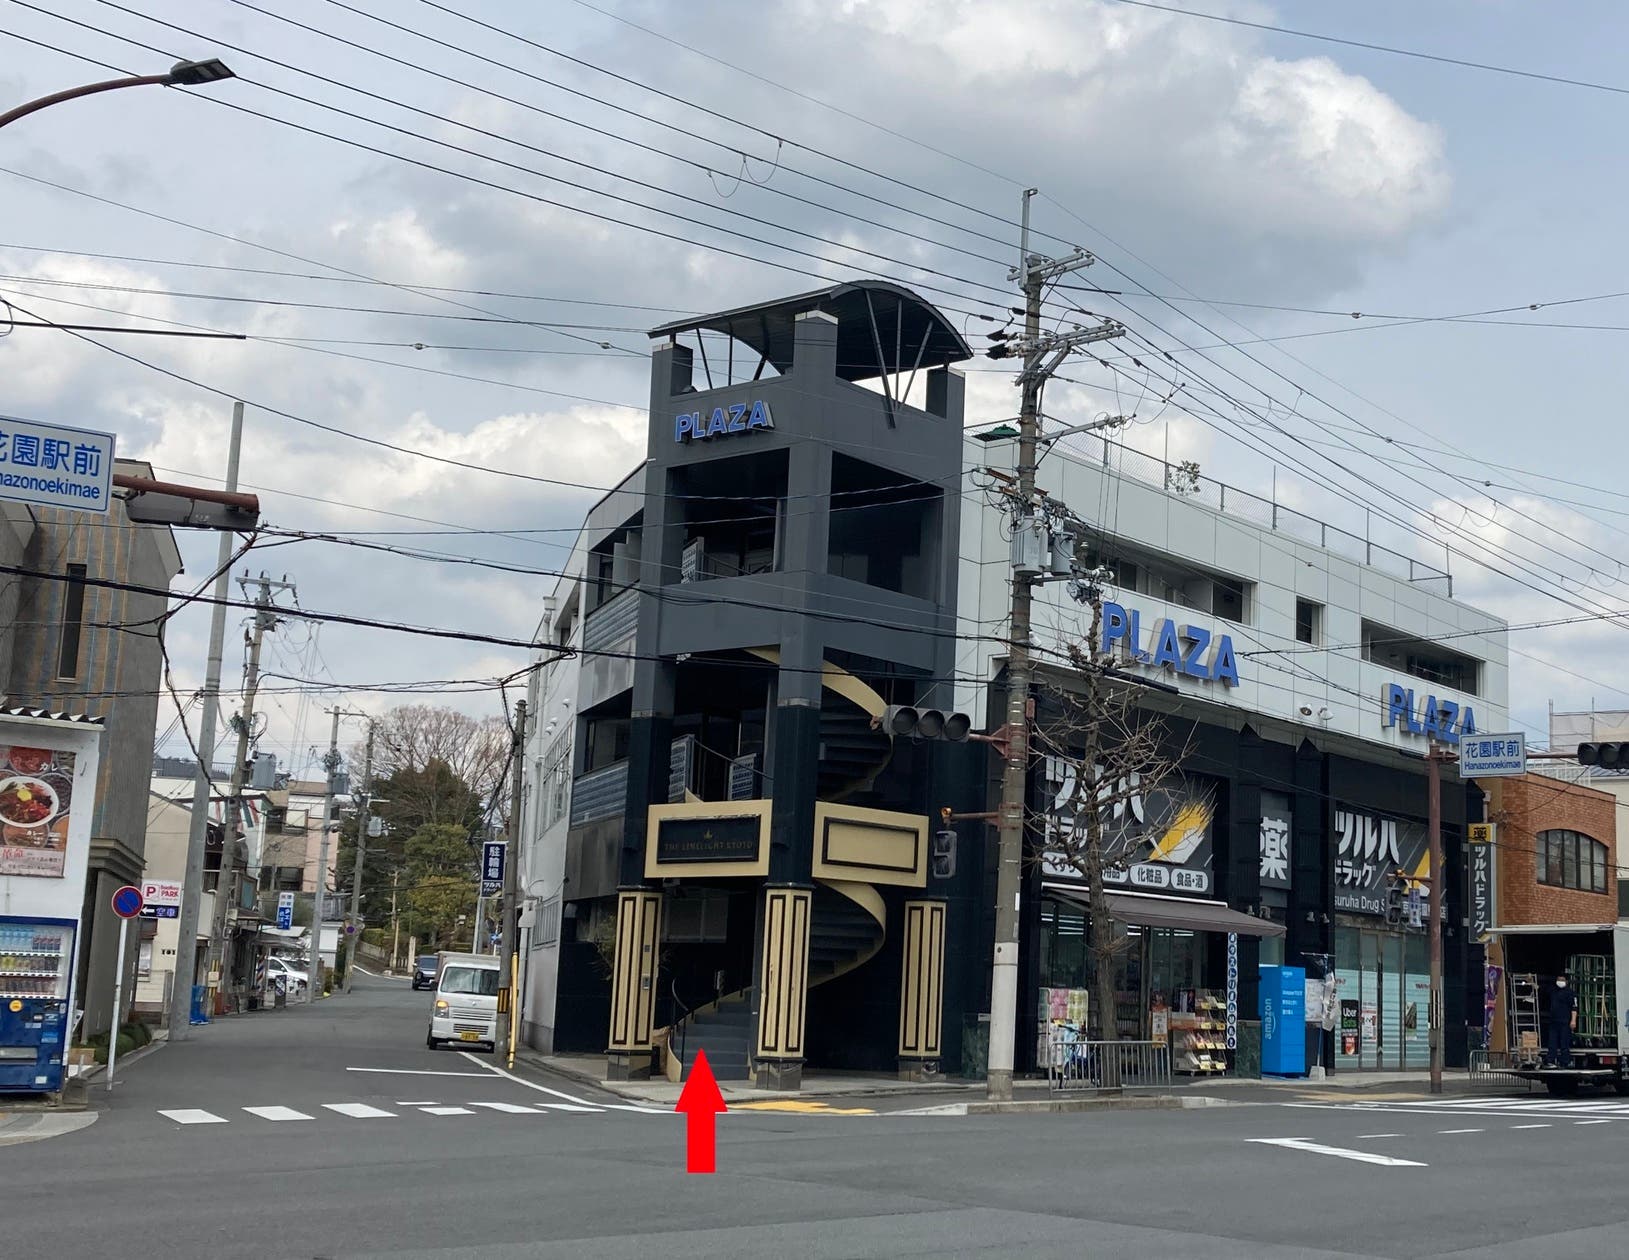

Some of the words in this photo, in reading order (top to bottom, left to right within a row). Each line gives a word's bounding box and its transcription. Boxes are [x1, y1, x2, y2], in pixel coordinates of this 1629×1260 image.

[675, 400, 773, 442] PLAZA
[1101, 601, 1240, 688] PLAZA
[1382, 683, 1476, 745] PLAZA
[1464, 760, 1521, 771] Hanazonoekimae
[1465, 740, 1520, 759] 花園駅前
[1260, 816, 1288, 880] 薬
[1335, 810, 1399, 865] ツルハ
[146, 886, 156, 897] P
[1137, 867, 1163, 884] 化粧品
[1474, 846, 1489, 933] ツルハドラッグ
[1335, 894, 1359, 908] suruha
[1361, 896, 1379, 913] Drug
[1264, 998, 1272, 1040] amazon
[1343, 1008, 1357, 1017] Uber
